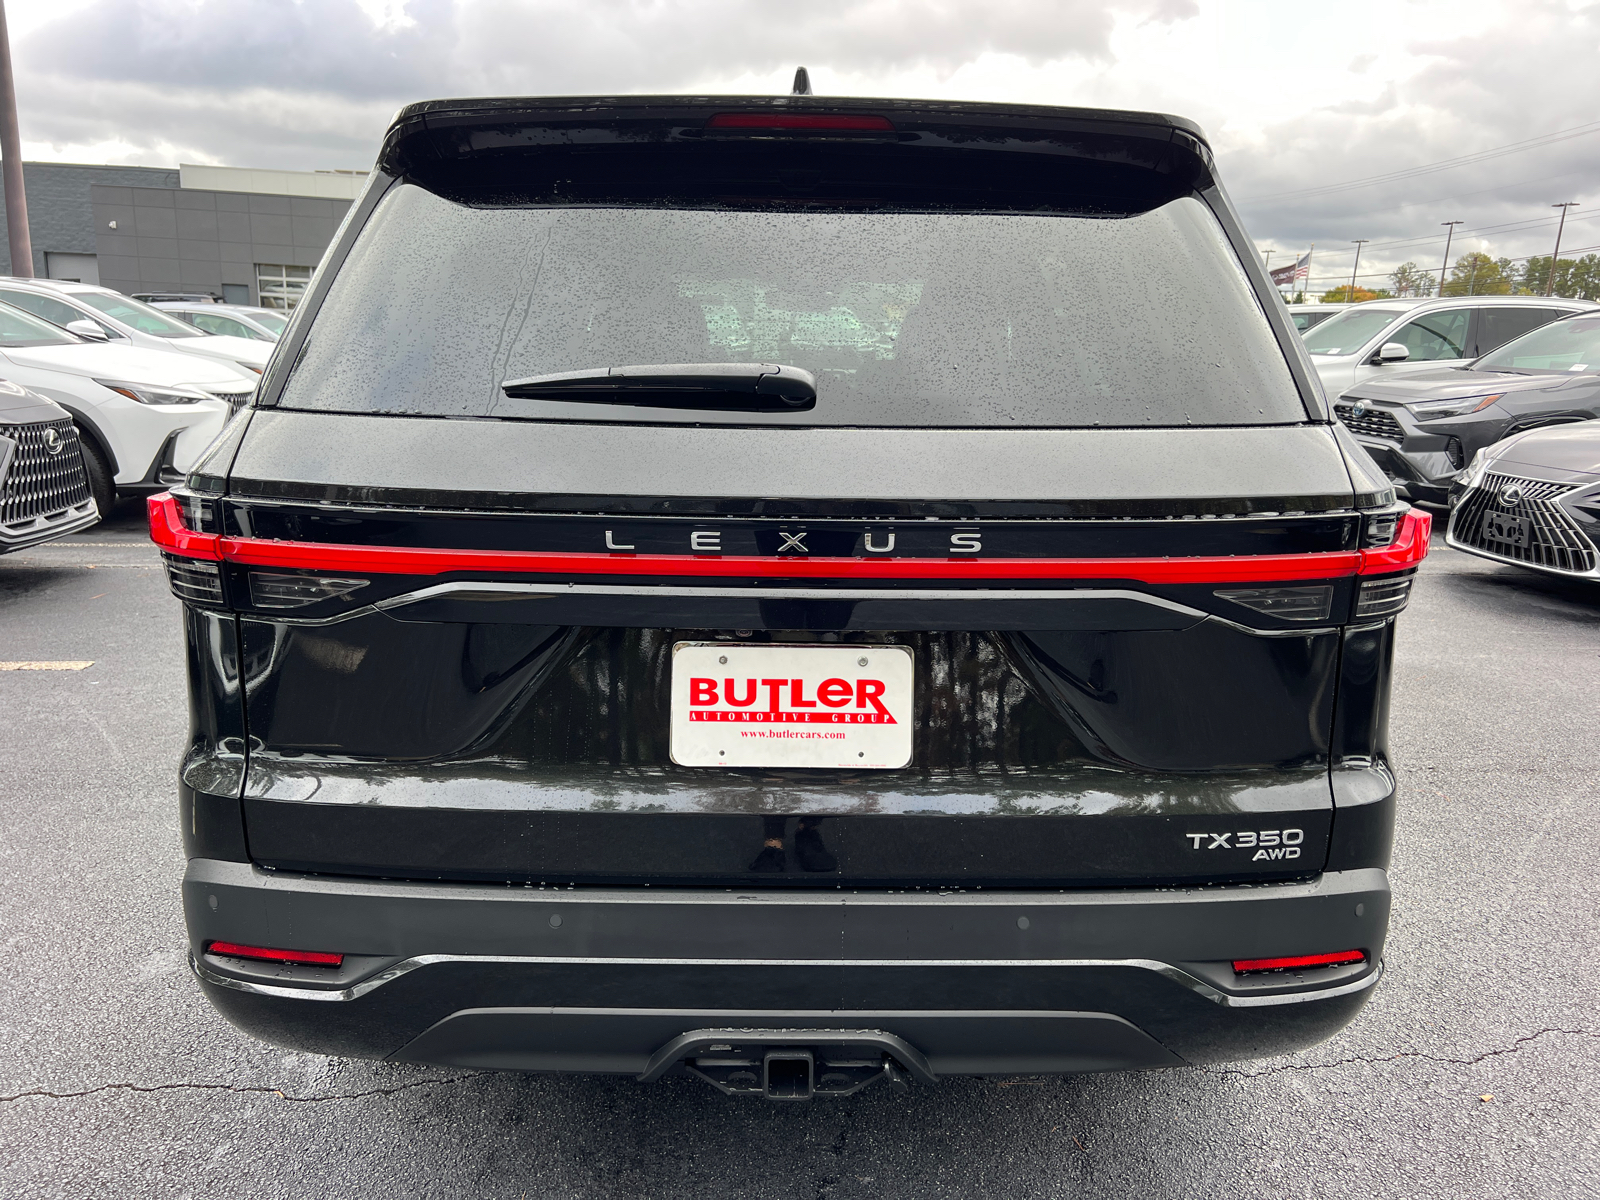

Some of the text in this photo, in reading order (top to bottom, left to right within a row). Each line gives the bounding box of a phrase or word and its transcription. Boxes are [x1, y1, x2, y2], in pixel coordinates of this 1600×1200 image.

[604, 530, 982, 554] LEXUS
[690, 711, 890, 724] AUTOMOTIVE GROUP
[740, 729, 846, 740] www.butlercars.com
[1251, 846, 1301, 862] AWD
